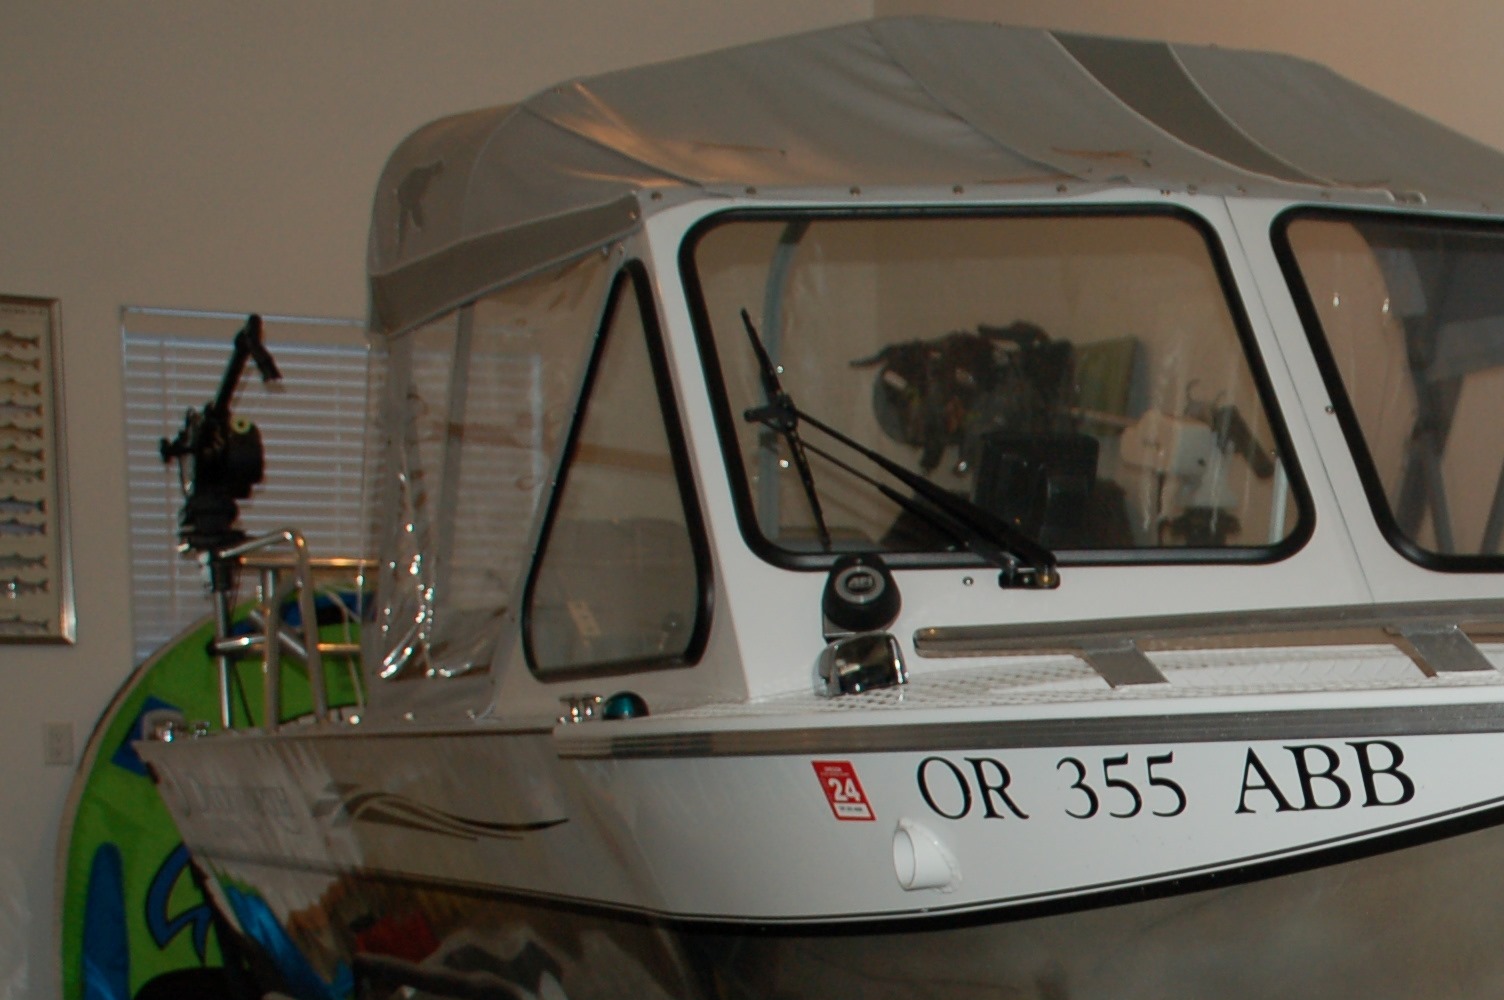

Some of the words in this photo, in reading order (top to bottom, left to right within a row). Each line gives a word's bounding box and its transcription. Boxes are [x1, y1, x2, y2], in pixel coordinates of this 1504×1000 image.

[829, 778, 862, 802] 24
[917, 757, 1029, 819] OR
[1057, 752, 1186, 819] 355
[1235, 741, 1414, 813] ABB
